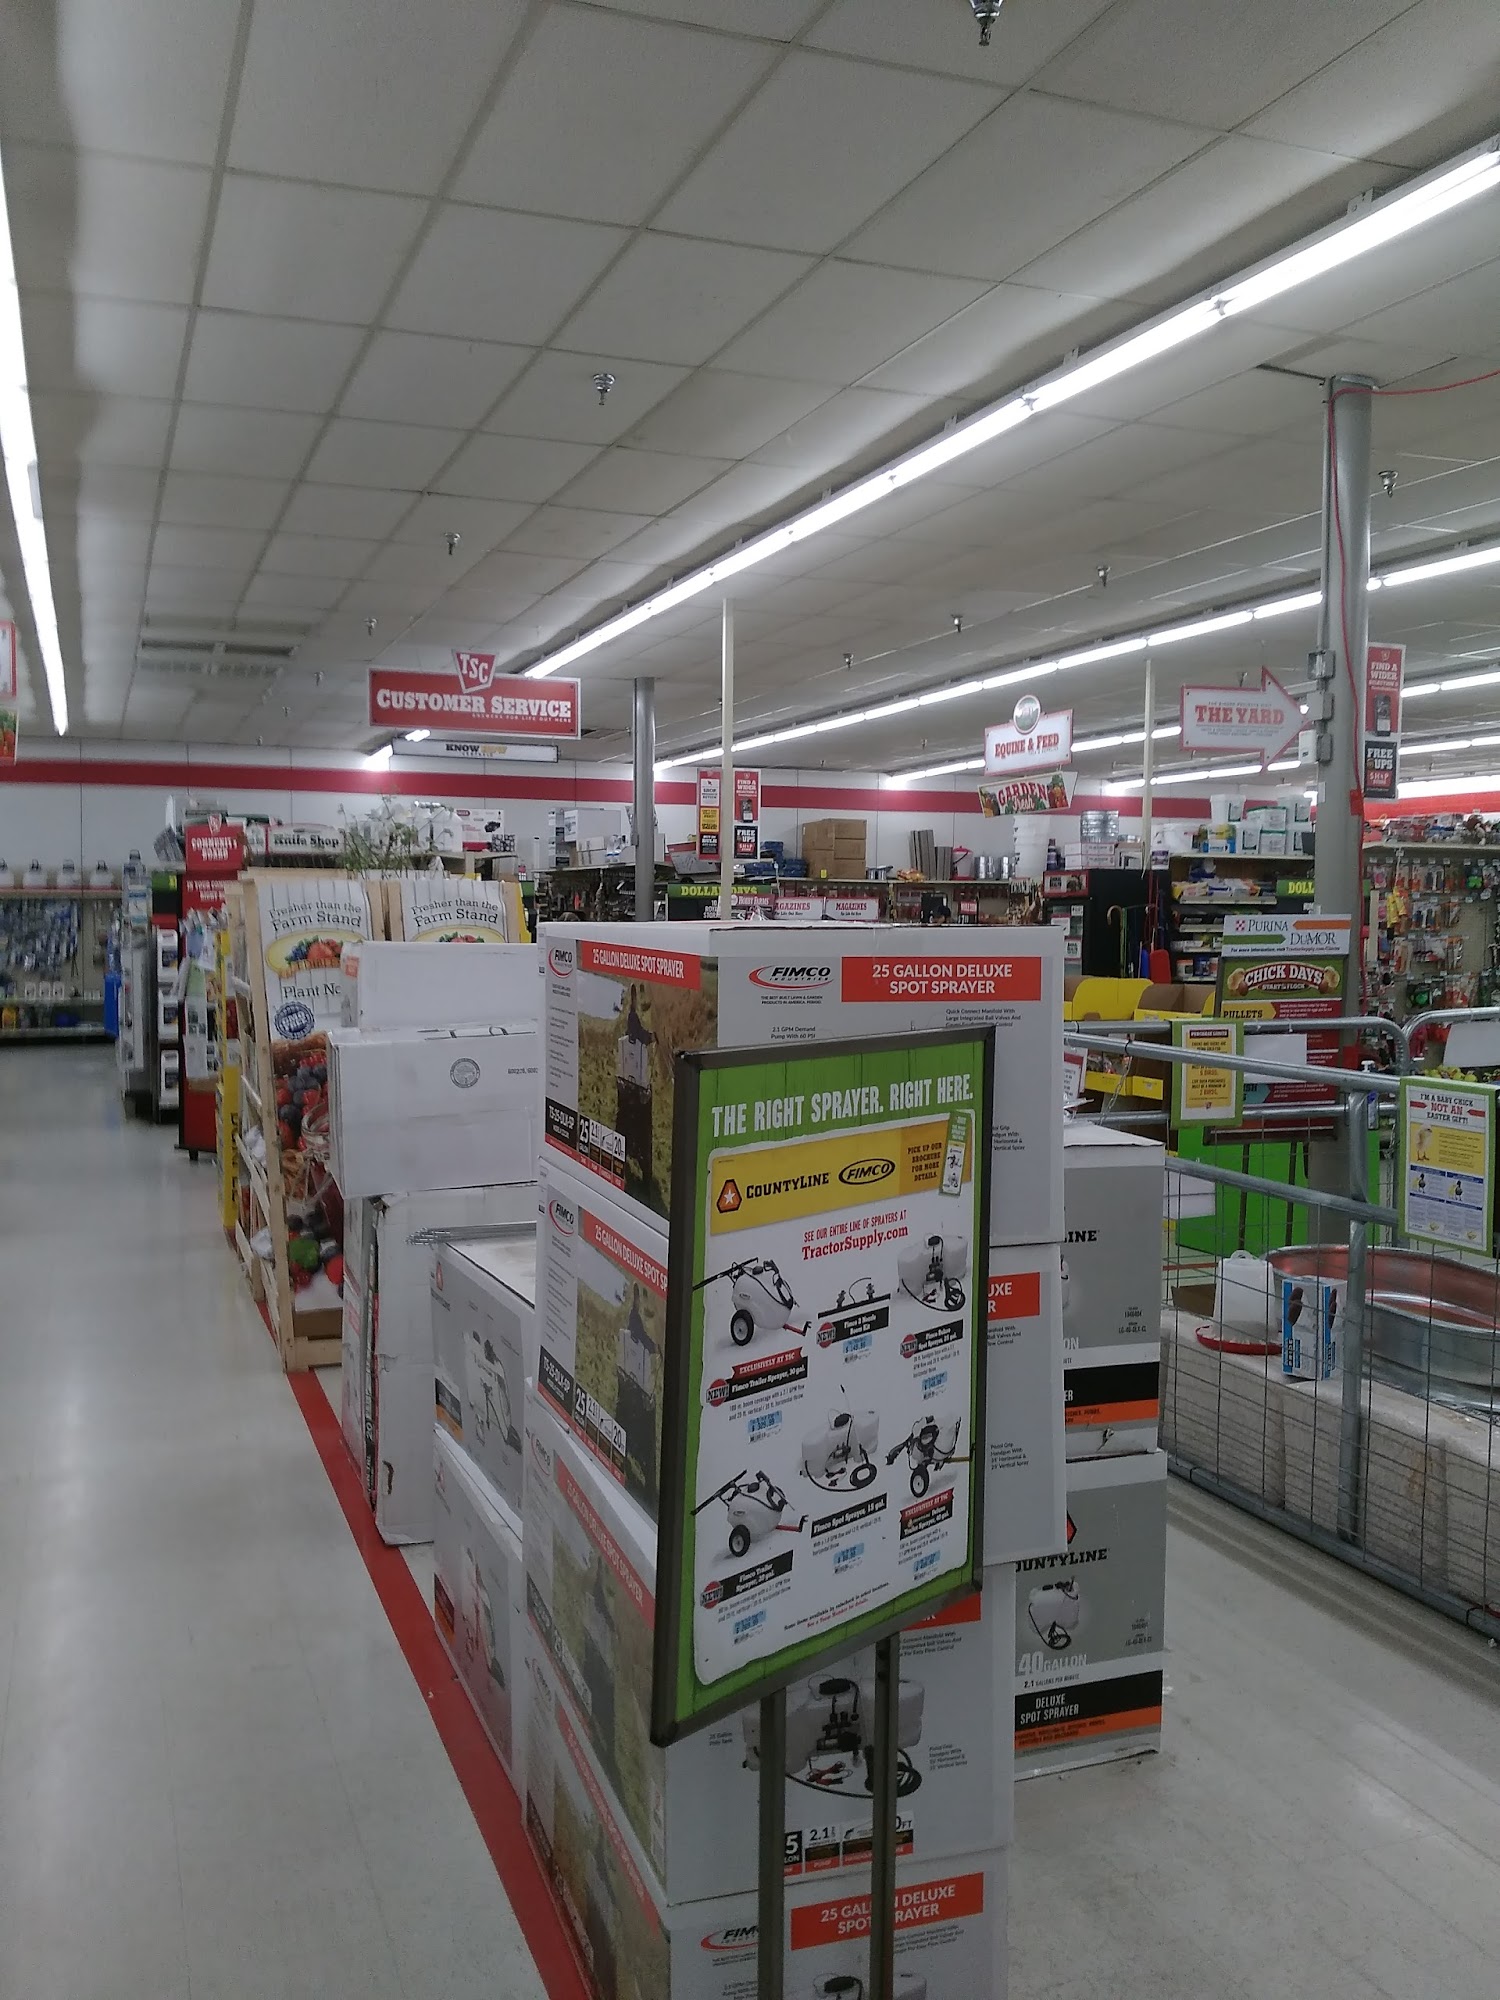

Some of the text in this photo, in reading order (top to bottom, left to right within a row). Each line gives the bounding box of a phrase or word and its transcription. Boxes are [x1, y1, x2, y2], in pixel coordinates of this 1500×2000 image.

[459, 653, 489, 683] TSC
[1371, 662, 1390, 671] FIND
[1371, 671, 1397, 680] WIDER
[377, 689, 571, 718] CUSTOMER SERVICE
[1195, 705, 1284, 724] THE YARD
[446, 744, 479, 752] KNOW
[995, 733, 1059, 759] EQUINE & FEED
[1367, 748, 1393, 758] FREE
[1375, 759, 1392, 769] UPS
[998, 782, 1047, 806] GARDEN
[1013, 796, 1035, 811] Fresh
[274, 834, 339, 848] Knife Shop
[681, 886, 721, 895] DOLLA
[1288, 882, 1314, 894] DOLL
[269, 901, 362, 919] Fresher than the
[411, 898, 498, 914] Fresher than the
[836, 902, 867, 910] MAGAZINES
[271, 911, 361, 932] Farm Stand
[413, 908, 498, 928] Farm Stand
[1248, 920, 1288, 932] PURINA
[554, 947, 573, 964] FIMCO
[592, 949, 684, 979] 25 GALLON DELUXE SPOT SPRAYER
[771, 967, 831, 976] FIMCO
[872, 964, 1013, 978] 25 GALLON DELUXE
[1244, 965, 1323, 986] CHICK DAYS
[283, 986, 319, 998] Plant
[890, 981, 995, 994] SPOT SPRAYER
[1223, 1010, 1262, 1019] PULLETS
[712, 1074, 973, 1138] THE RIGHT SPRAYER. RIGHT HERE.
[1431, 1103, 1463, 1115] NOT AN
[1436, 1095, 1452, 1104] BABY
[1453, 1098, 1473, 1107] CHICK
[1427, 1112, 1468, 1124] EASTER GIFT!
[580, 1119, 589, 1143] 25
[615, 1136, 621, 1156] 20
[908, 1145, 920, 1154] PICK
[912, 1152, 941, 1163] BROCHURE
[924, 1162, 939, 1170] MORE
[846, 1163, 890, 1180] FIMCO
[554, 1202, 574, 1226] FIMCO
[804, 1210, 907, 1242] SEE OUR ENTIRE LINE OF SPRAYERS AT
[802, 1224, 908, 1260] TractorSupply.com
[595, 1224, 660, 1286] 25 GALLON DELUXE SPOT
[817, 1327, 836, 1344] NEW!
[900, 1338, 917, 1355] NEW!
[739, 1352, 795, 1375] EXCLUSIVELY AT TSC
[731, 1382, 749, 1393] Fimco
[749, 1377, 766, 1389] Trailer
[767, 1371, 789, 1385] Sprayer,
[796, 1365, 805, 1375] gal.
[707, 1385, 730, 1402] NEW!
[575, 1386, 586, 1419] 25
[613, 1423, 622, 1449] 20
[813, 1521, 831, 1534] Fimco
[832, 1514, 844, 1528] Spot
[867, 1503, 875, 1513] 15
[875, 1500, 885, 1511] gal.
[1016, 1549, 1108, 1573] UNTYLINE
[700, 1585, 724, 1606] NEW!
[1019, 1651, 1088, 1674] 40 GALLON
[1024, 1680, 1034, 1688] 2.1
[1036, 1693, 1066, 1709] DELUXE
[1020, 1704, 1079, 1725] SPOT SPRAYER
[810, 1827, 828, 1841] 2.1
[785, 1835, 798, 1854] 5
[821, 1909, 838, 1923] 25
[902, 1884, 956, 1907] DELUXE
[895, 1903, 940, 1924] RAYER
[723, 1925, 760, 1940] FIM
